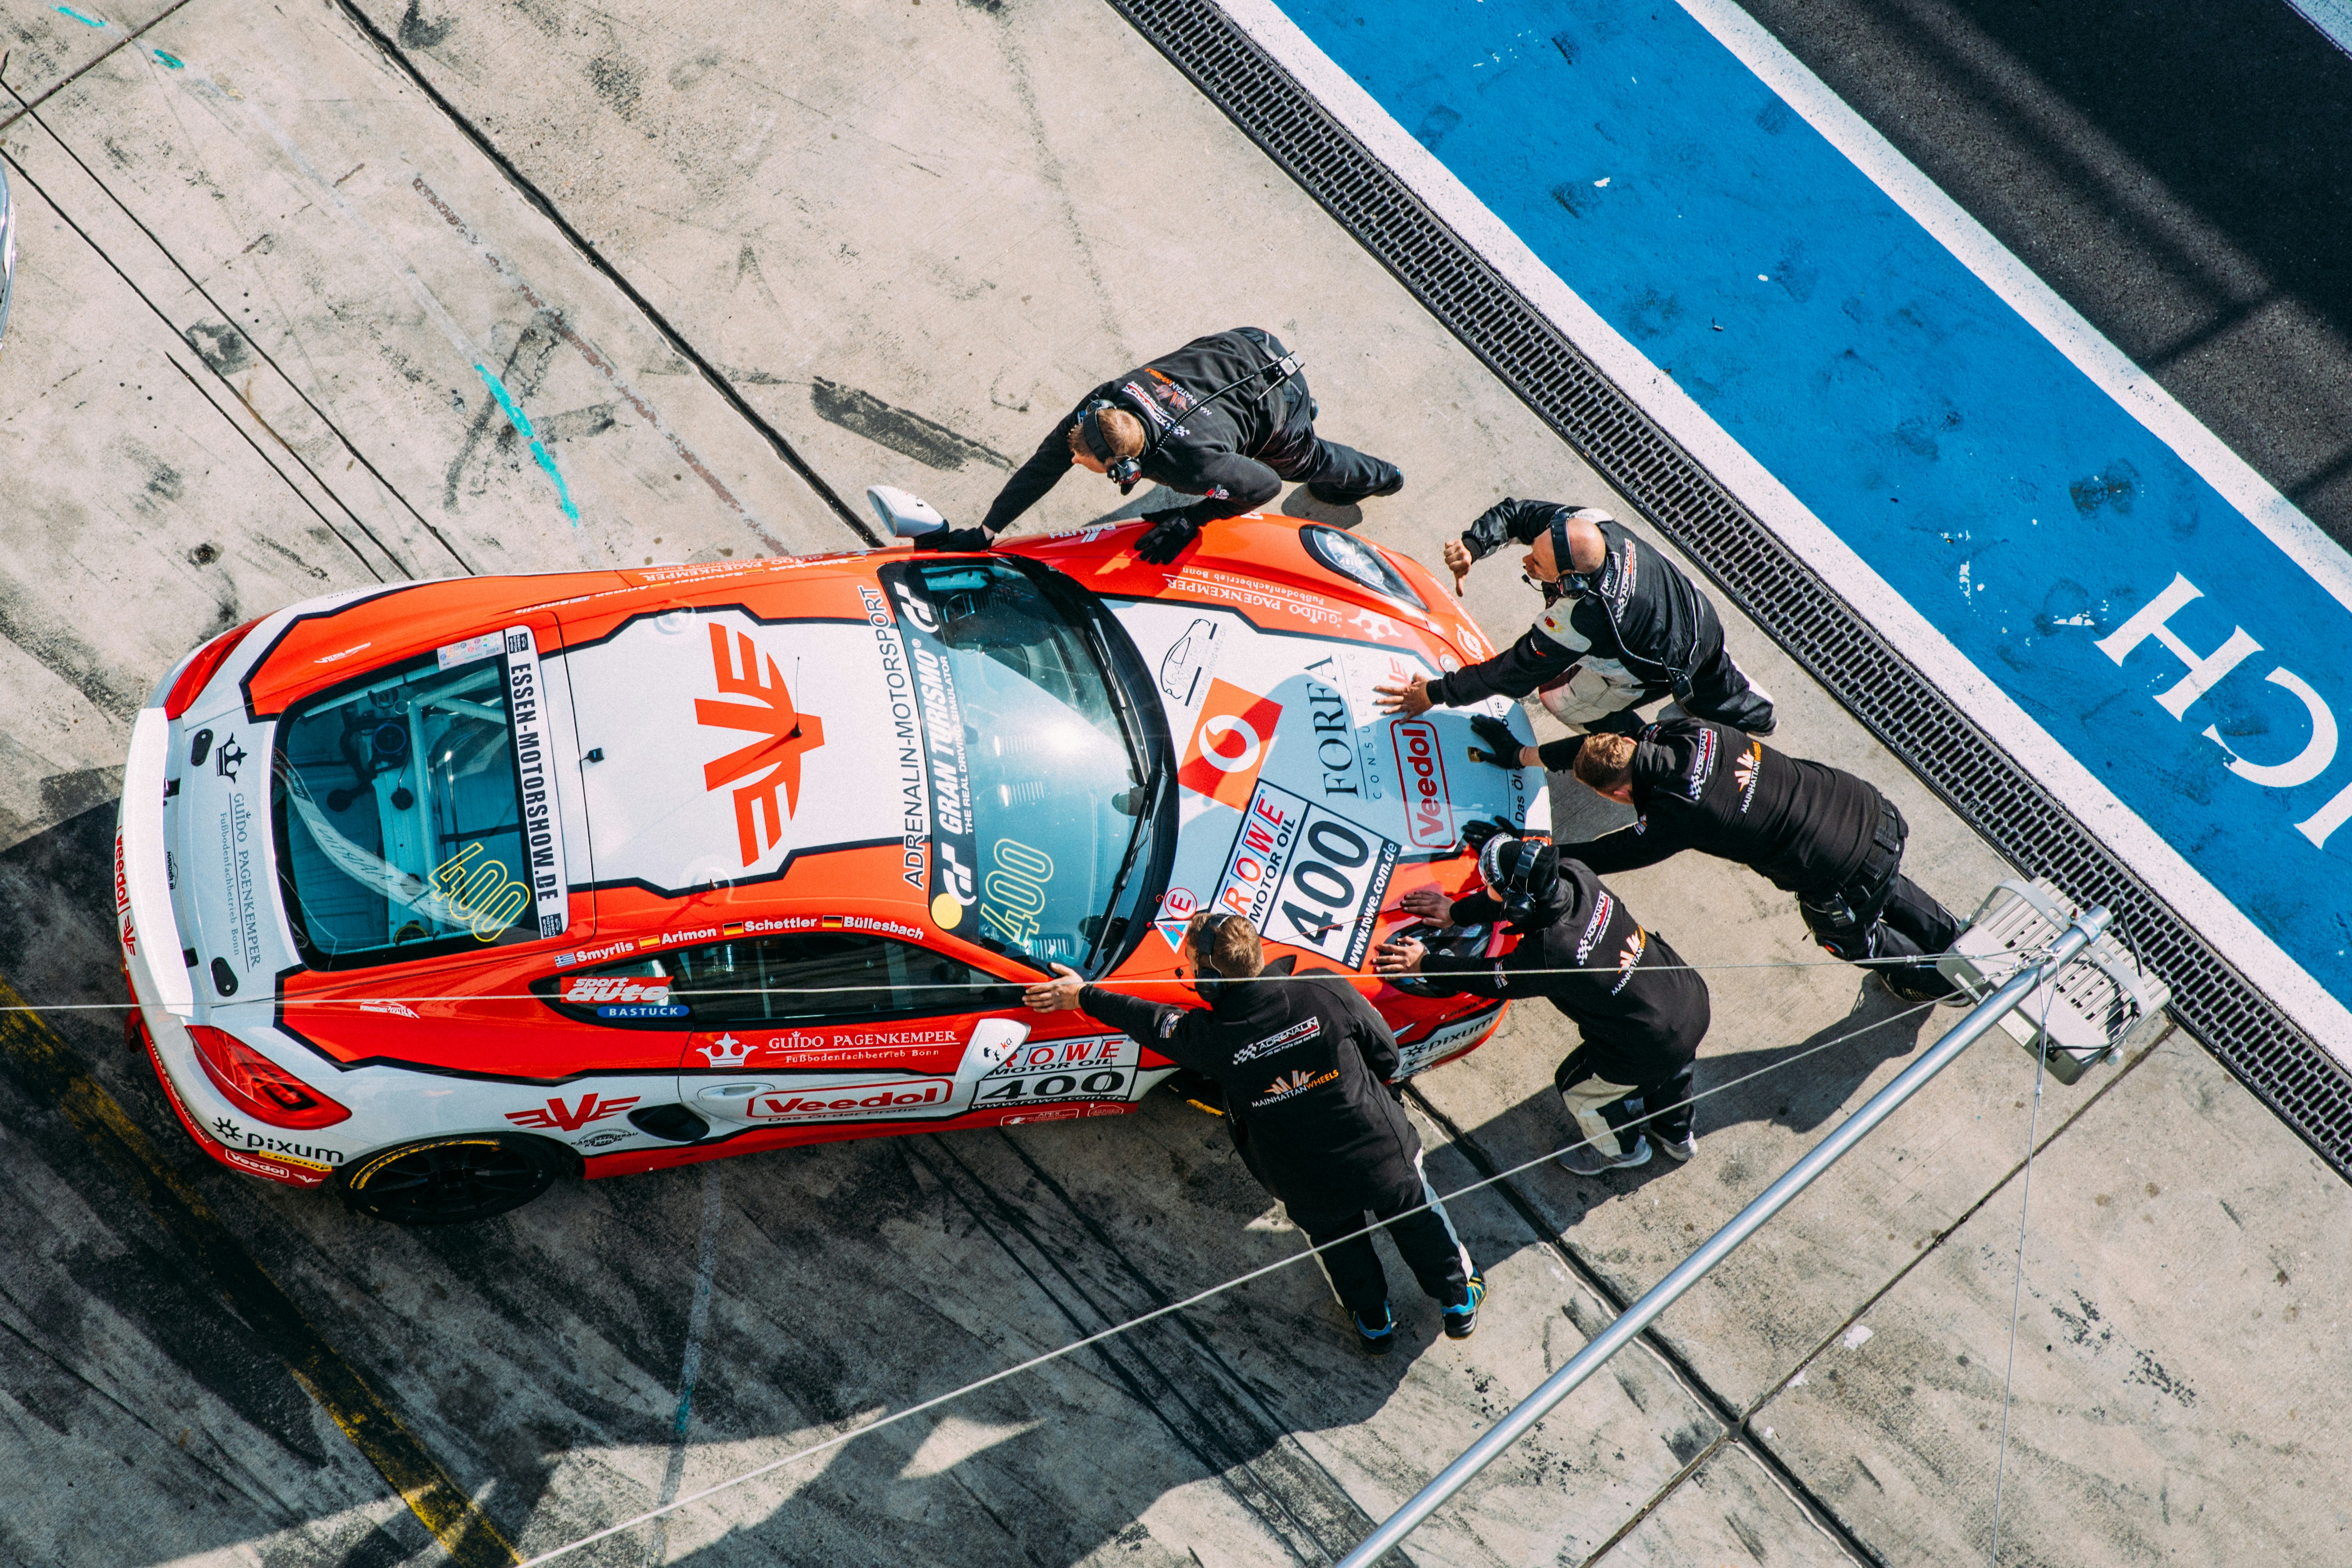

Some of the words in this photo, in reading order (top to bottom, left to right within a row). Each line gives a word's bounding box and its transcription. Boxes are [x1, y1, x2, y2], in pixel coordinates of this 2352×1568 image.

[1182, 567, 1209, 579] Bonn
[1166, 578, 1280, 610] PAGENKEMPER
[1289, 603, 1339, 623] GUIDO
[940, 655, 959, 721] SIMULATOR
[858, 585, 925, 890] ADRENALIN-MOTORSPORT
[1304, 654, 1358, 798] FORFA
[1347, 653, 1382, 799] CONSULTING
[954, 724, 967, 773] DRIVING
[511, 663, 558, 902] ESSEN-MOTORSHOW.DE
[933, 759, 963, 835] GRAN
[960, 776, 971, 807] REAL
[1402, 728, 1444, 838] Veedol
[1512, 773, 1524, 791] Öl
[234, 793, 250, 843] GUIDO
[962, 808, 973, 835] THE
[1516, 796, 1525, 824] Das
[220, 812, 236, 925] Fußbodenfachbetrieb
[232, 929, 240, 956] Bonn
[1249, 852, 1283, 924] MOTOR
[1277, 819, 1295, 847] OIL
[1282, 821, 1369, 947] 400
[428, 841, 531, 942] 400
[980, 838, 1053, 946] 400
[1347, 842, 1397, 969] www.rowe.com.de
[238, 850, 261, 968] PAGENKEMPER
[576, 941, 634, 963] Smyrlis
[662, 927, 717, 945] Arimon
[745, 917, 817, 932] Schettler
[844, 916, 925, 940] Büllesbach
[565, 984, 671, 1002] auto
[573, 977, 629, 989] sport
[608, 1006, 679, 1017] BASTUCK
[769, 1033, 824, 1049] GUIDO
[833, 1030, 957, 1046] PAGENKEMPER
[1259, 1019, 1318, 1051] ADRENALIN
[1428, 1017, 1493, 1052] pixum
[786, 1049, 906, 1064] Fußbodenfachbetrieb
[912, 1049, 939, 1057] Bonn
[989, 1062, 1071, 1076] MOTOR
[764, 1088, 938, 1113] Veedol
[981, 1071, 1125, 1100] 400
[971, 1095, 1127, 1110] www.rowe.com.de
[230, 1152, 285, 1175] Veedol
[247, 1133, 344, 1163] pixum
[273, 1155, 330, 1170] DUNLOP
